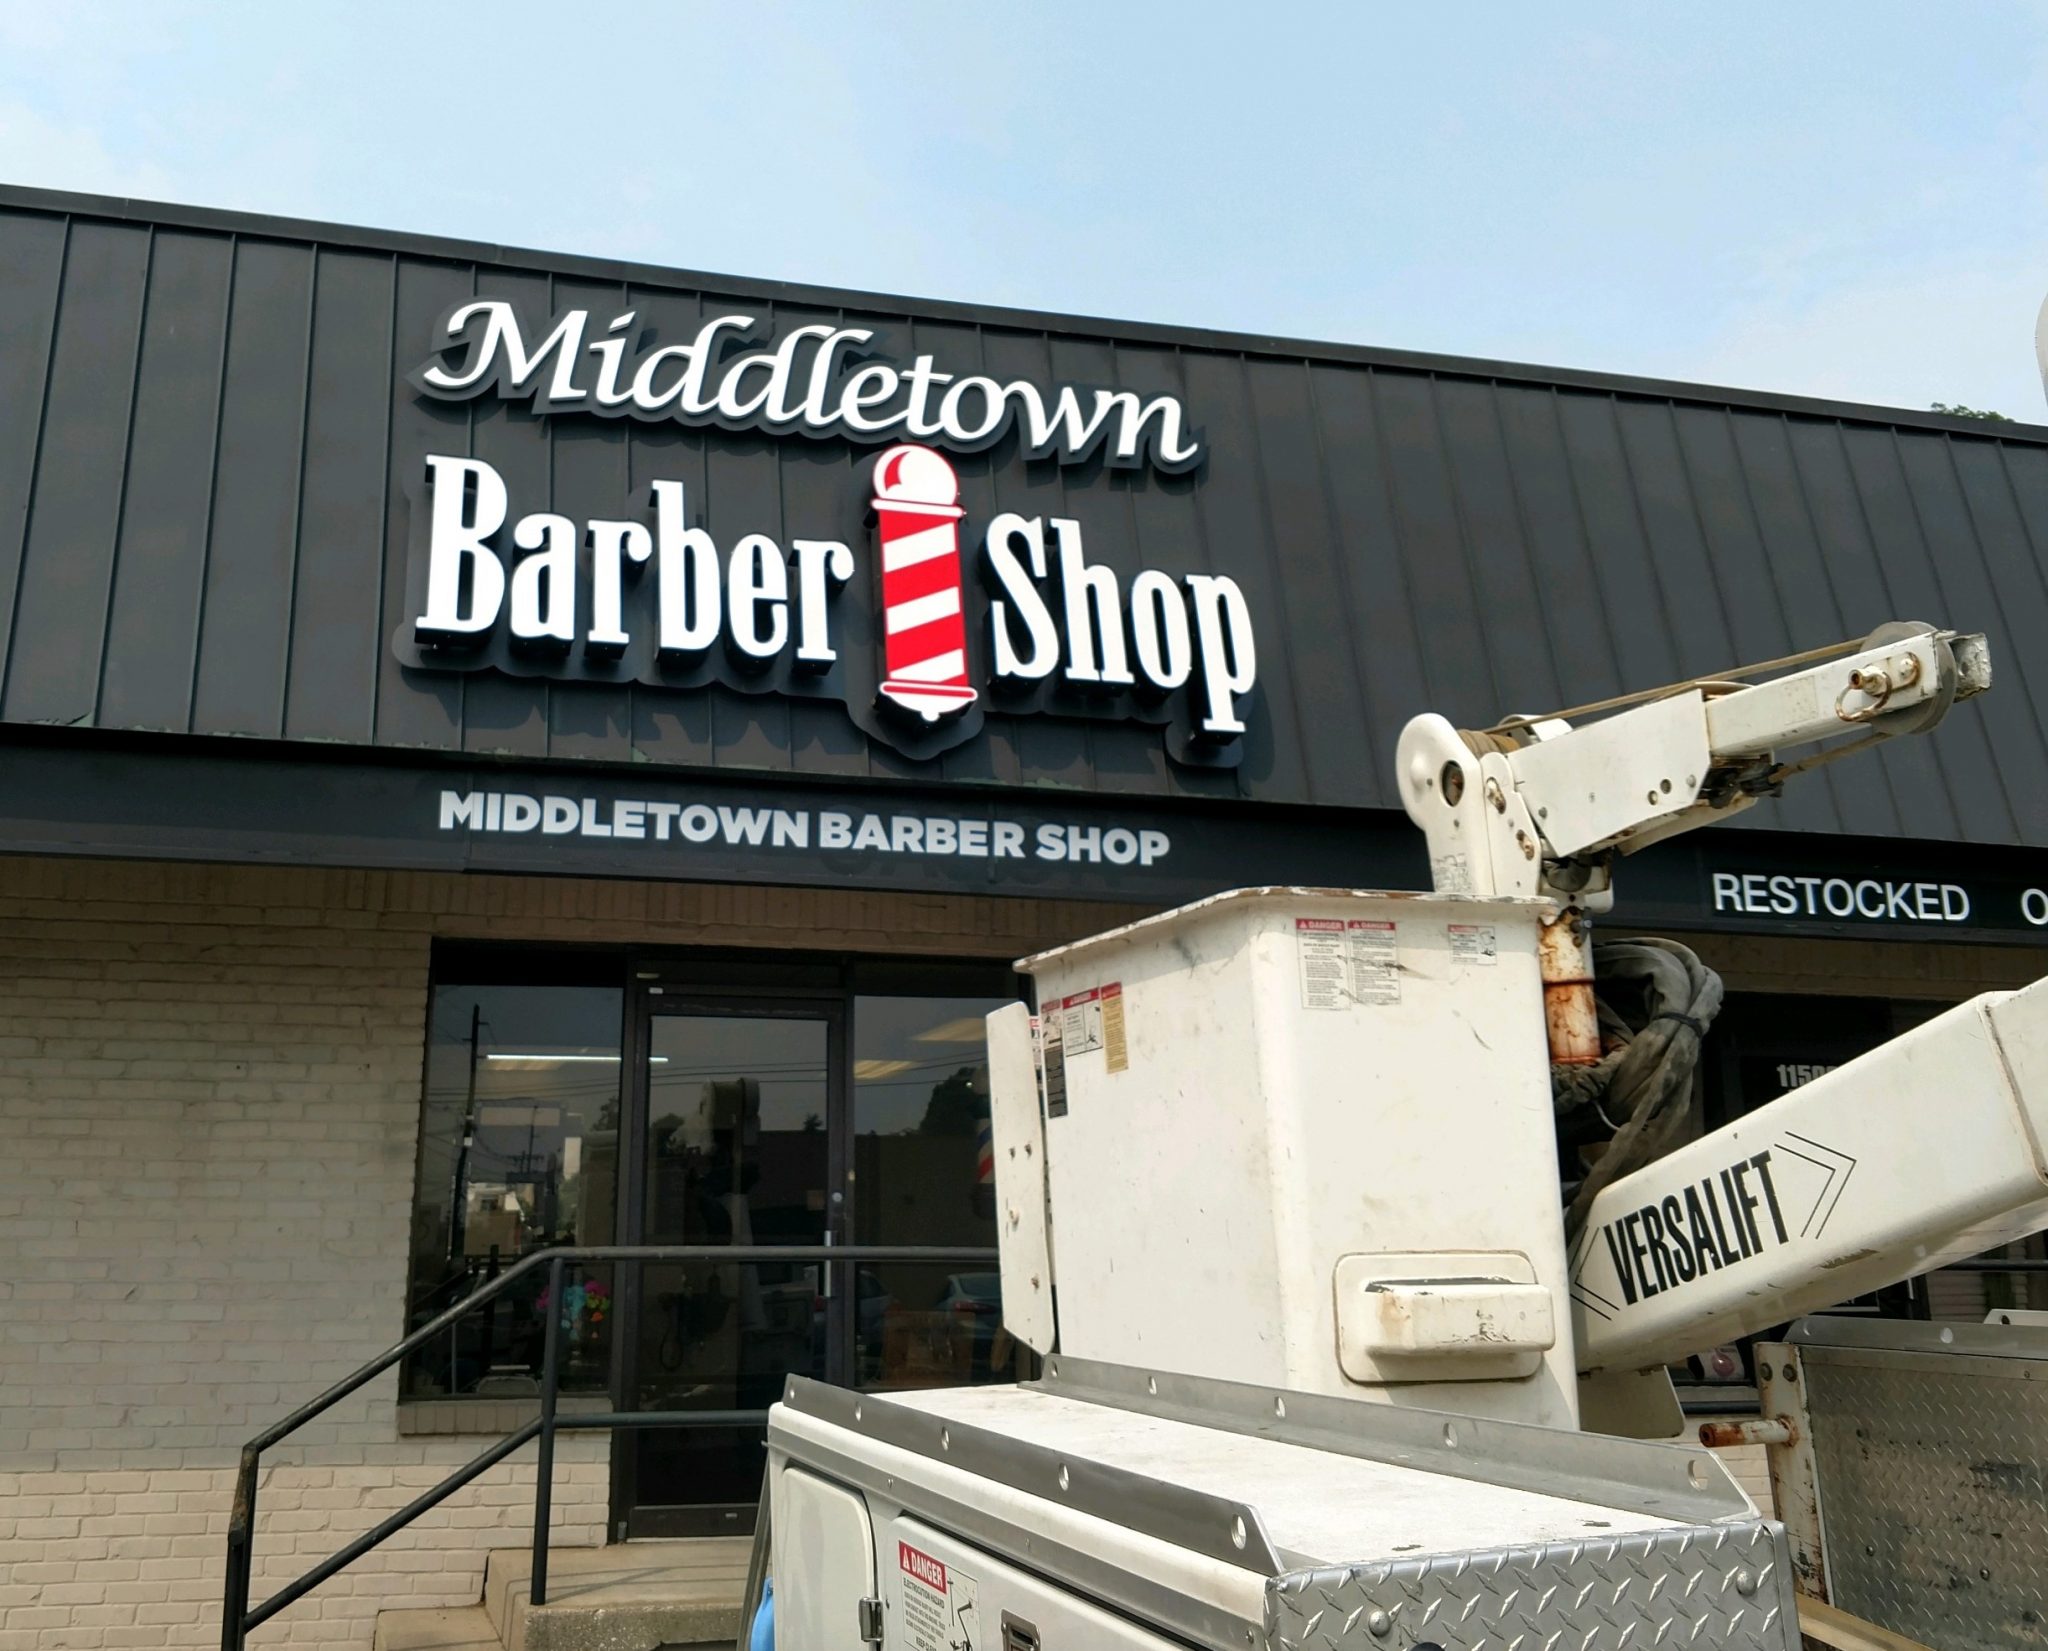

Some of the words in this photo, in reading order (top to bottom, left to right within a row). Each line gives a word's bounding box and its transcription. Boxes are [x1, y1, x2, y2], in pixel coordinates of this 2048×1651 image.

[423, 301, 1199, 466] Middletown
[415, 454, 855, 663] Barber
[986, 513, 1257, 735] Shop
[439, 791, 809, 849] MIDDLETOWN
[819, 812, 1025, 859] BARBER
[1035, 824, 1171, 867] SHOP
[1308, 920, 1343, 930] DANGER
[1712, 872, 1970, 921] RESTOCKED
[1603, 1150, 1789, 1306] VERSALIFT
[911, 1551, 943, 1588] DANGER
